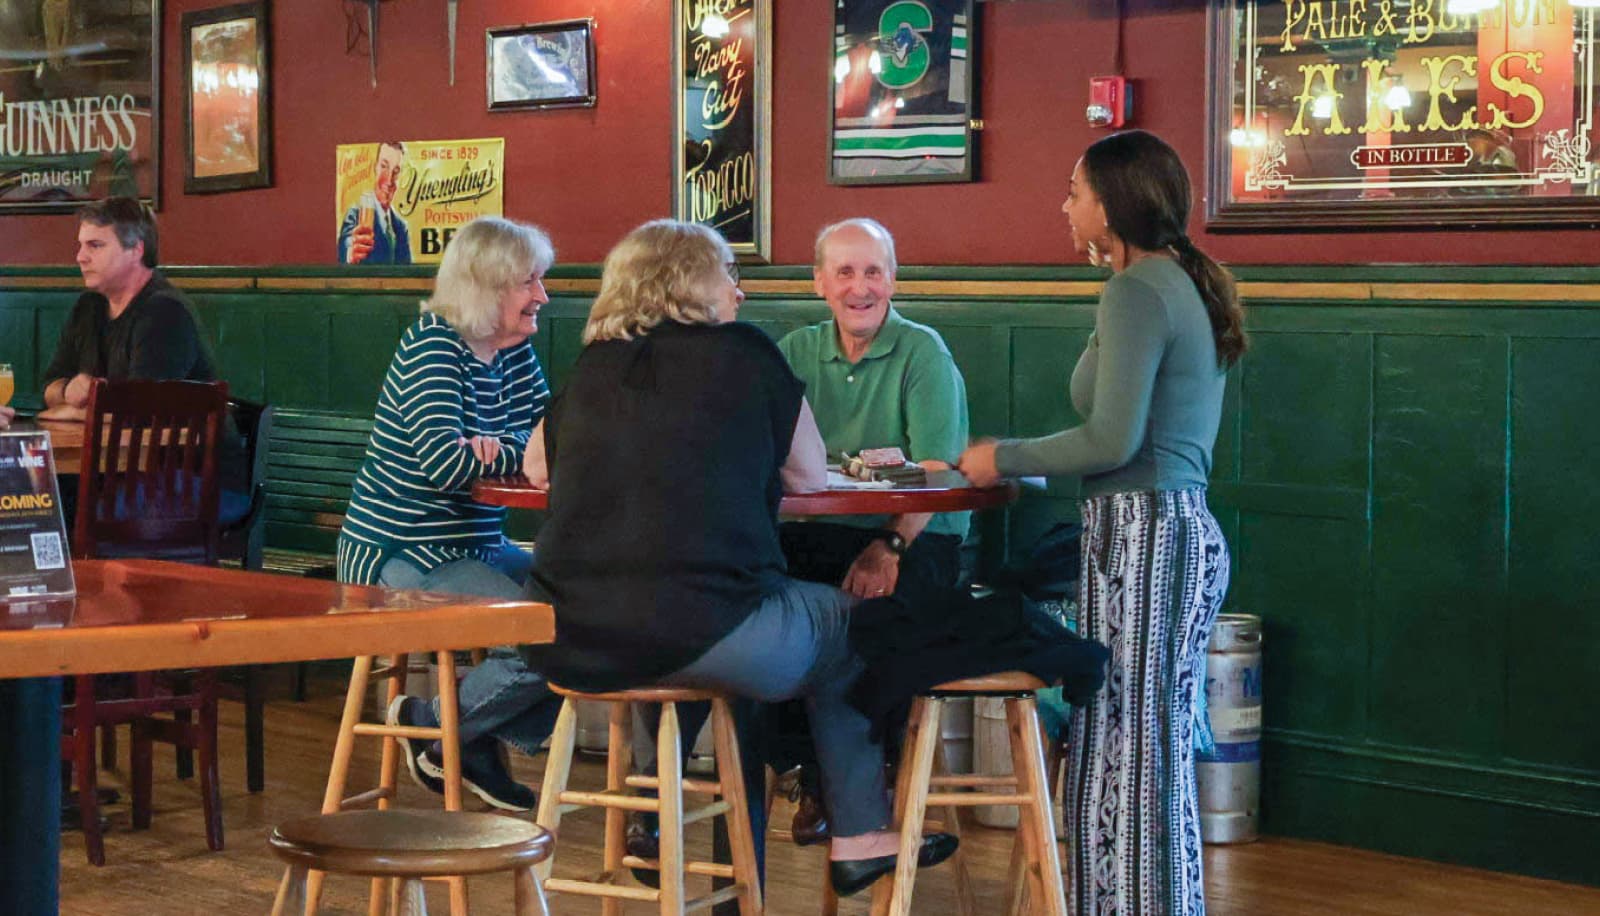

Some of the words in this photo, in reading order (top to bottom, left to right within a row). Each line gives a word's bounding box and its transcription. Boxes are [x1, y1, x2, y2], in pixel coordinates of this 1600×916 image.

[1280, 0, 1367, 52] PALE
[1372, 0, 1398, 37] &
[1402, 0, 1559, 44] BUON
[694, 38, 745, 81] Navy
[702, 70, 746, 124] Cut
[1284, 51, 1546, 137] ALES
[420, 148, 454, 160] SINCE
[457, 147, 479, 160] 1829
[1367, 150, 1388, 164] IN
[1390, 149, 1456, 164] BOTTLE
[21, 170, 92, 188] DRAUGHT
[399, 160, 496, 216] Yuengling's
[684, 140, 755, 225] TOBACCO
[0, 494, 53, 510] OMING
